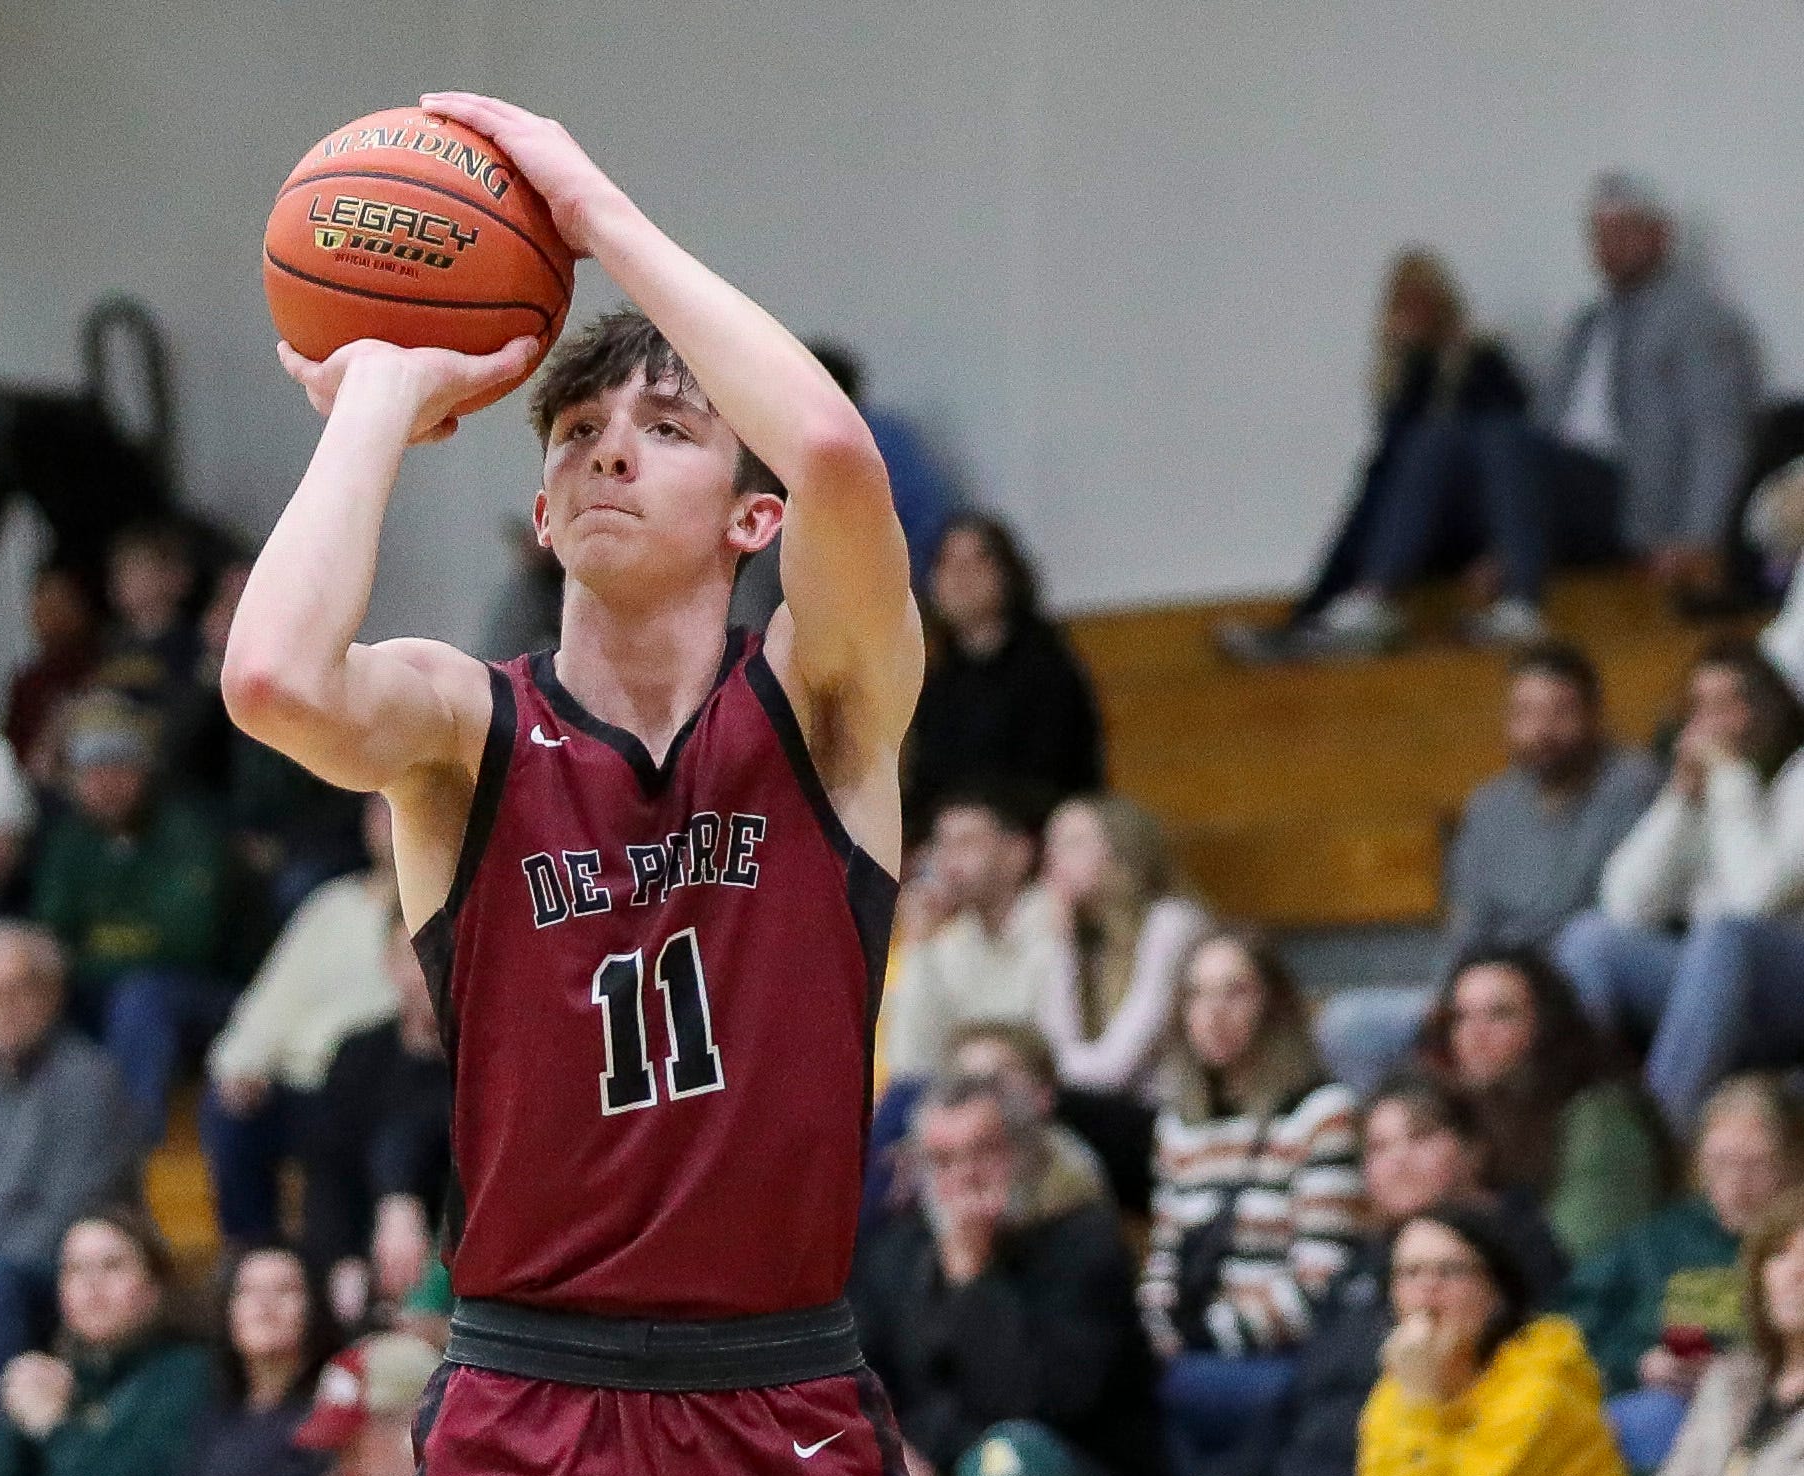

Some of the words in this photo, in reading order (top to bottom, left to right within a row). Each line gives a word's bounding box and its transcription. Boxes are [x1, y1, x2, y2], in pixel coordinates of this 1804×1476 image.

[308, 194, 479, 253] LEGACY
[522, 850, 611, 929] DE
[592, 927, 726, 1115] 11
